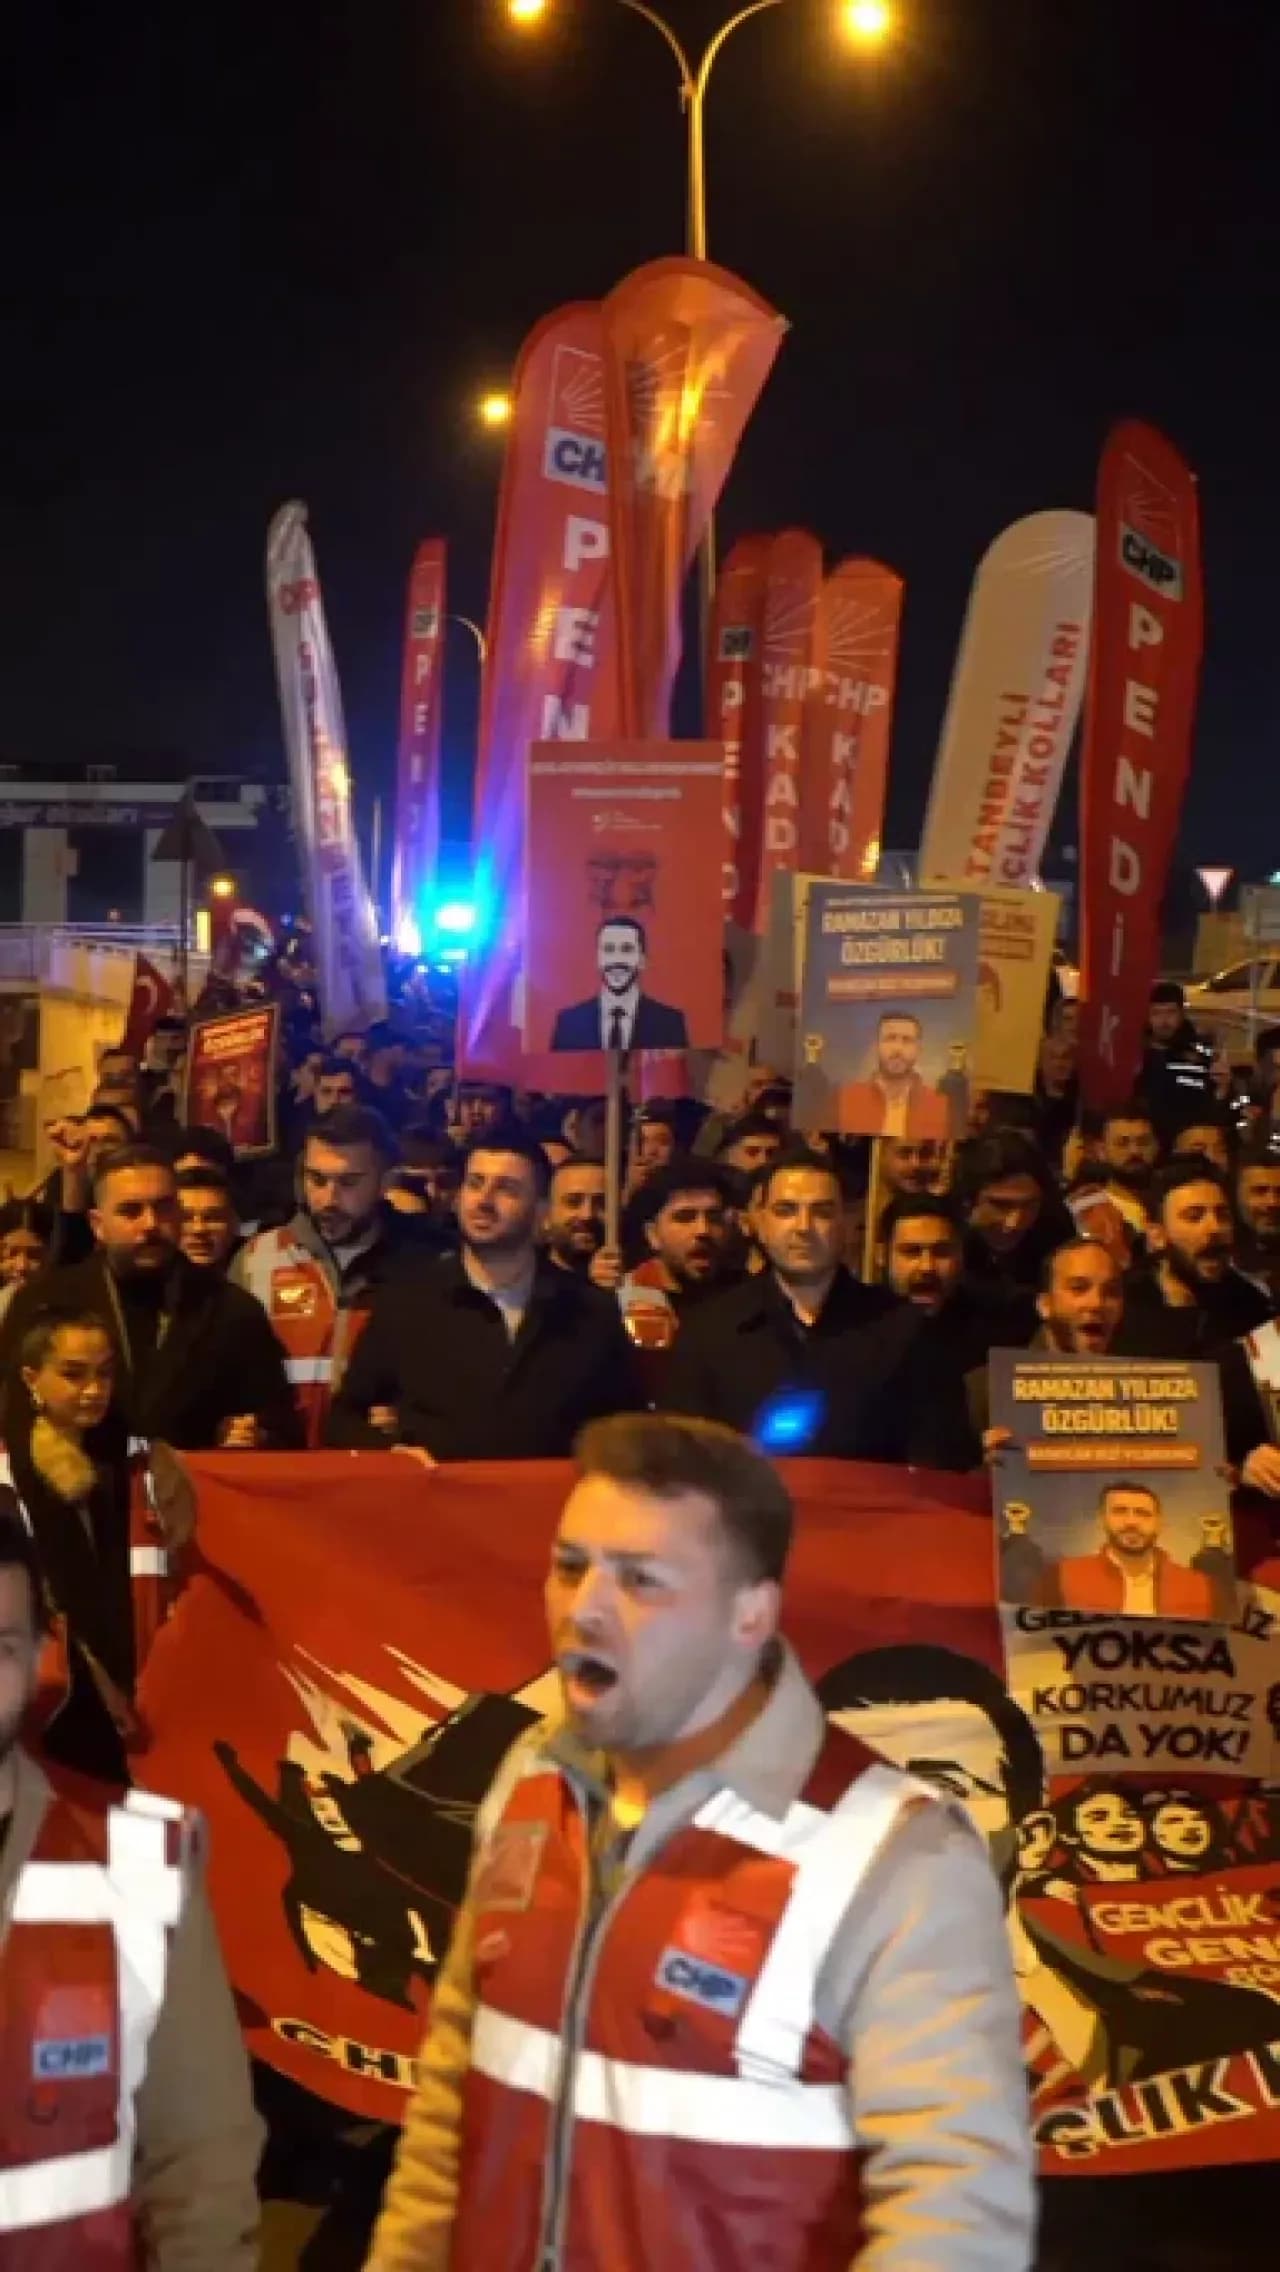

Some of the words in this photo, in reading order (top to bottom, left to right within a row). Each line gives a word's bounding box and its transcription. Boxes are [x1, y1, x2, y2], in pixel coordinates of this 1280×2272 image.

[553, 438, 608, 482] CH
[1122, 534, 1175, 582] CHP
[766, 724, 798, 869] KAD
[1053, 1631, 1236, 1677] YOKSA
[1033, 1682, 1256, 1720] KORKUMUZ
[1061, 1723, 1130, 1761] DA
[1139, 1724, 1251, 1762] YOK!
[1144, 1936, 1280, 1968] GEN
[664, 1957, 737, 1999] CHP
